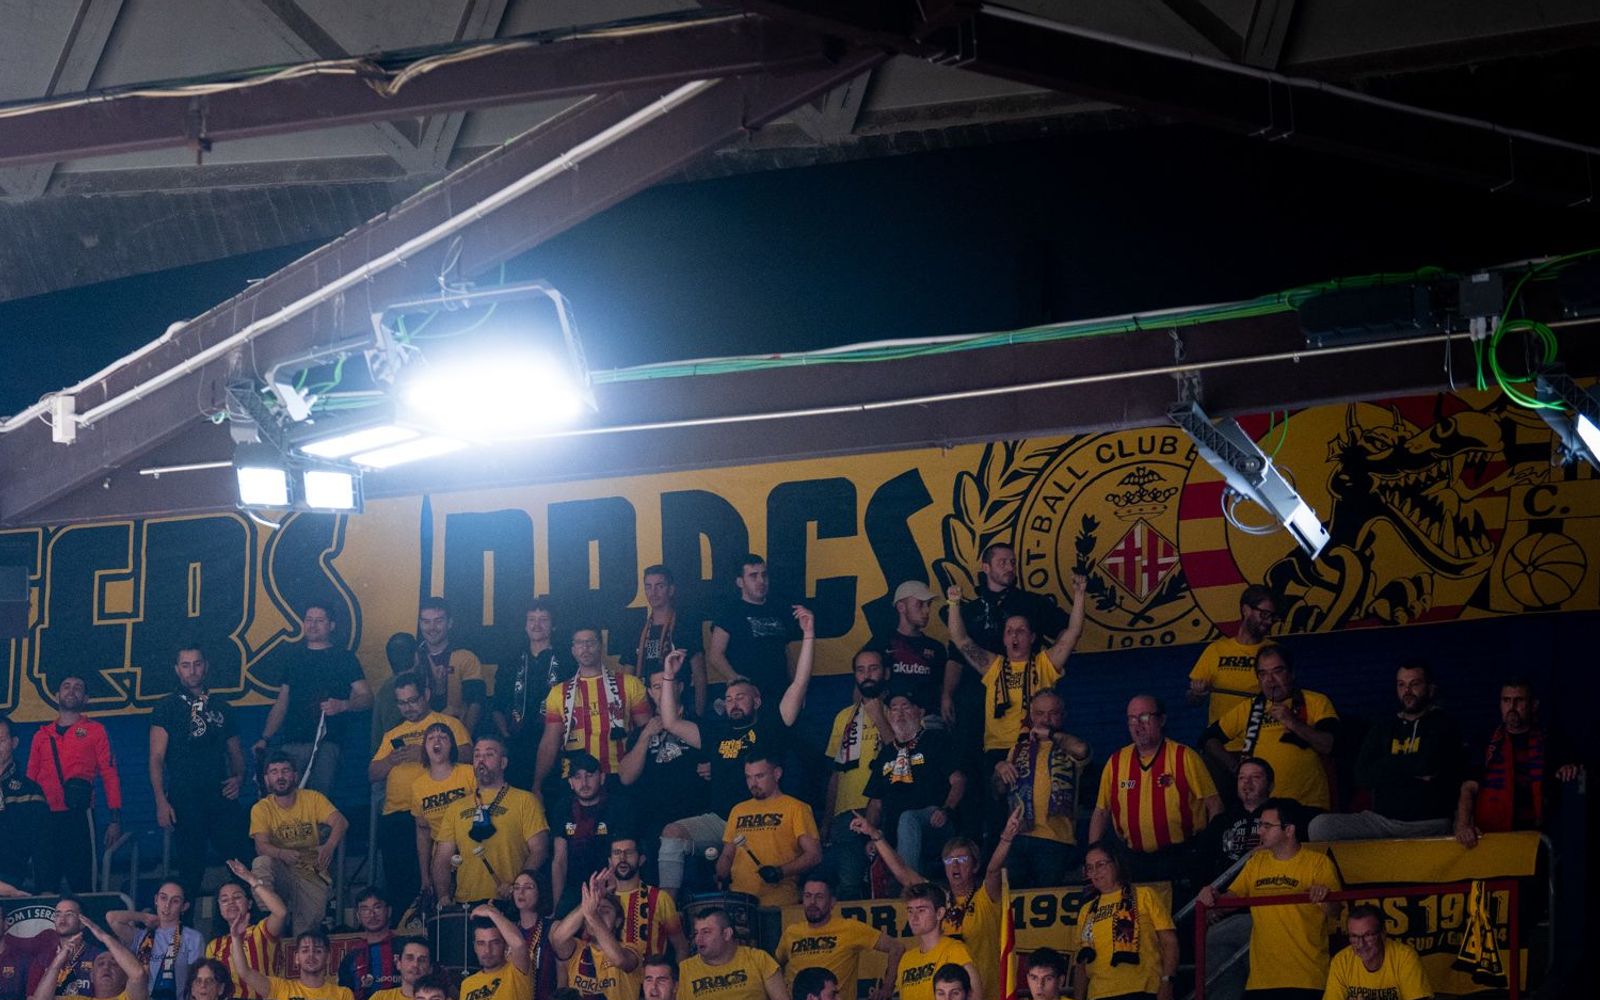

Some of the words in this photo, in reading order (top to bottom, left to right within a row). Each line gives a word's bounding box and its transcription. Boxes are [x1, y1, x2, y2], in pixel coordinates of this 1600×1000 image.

[1096, 435, 1179, 463] CLUB
[894, 661, 931, 675] akuten
[1219, 655, 1258, 668] DRAC
[422, 787, 465, 810] DRACS
[736, 813, 783, 829] DRACS
[1013, 892, 1081, 929] 199
[1417, 892, 1509, 934] 191
[791, 936, 837, 953] DRACS
[692, 969, 747, 994] DRACS
